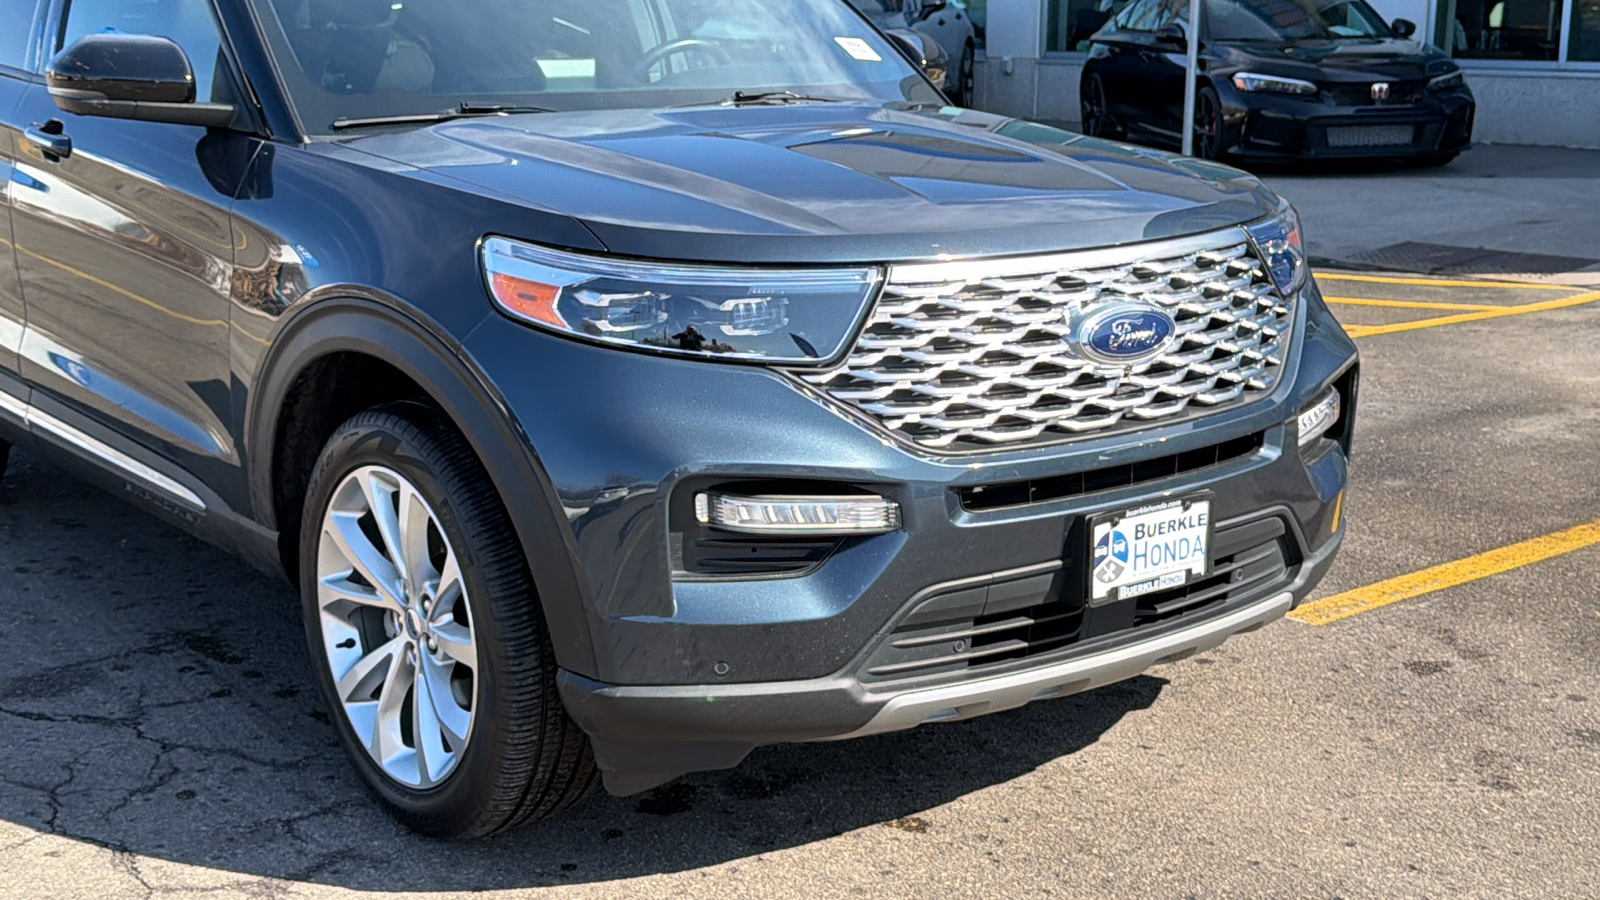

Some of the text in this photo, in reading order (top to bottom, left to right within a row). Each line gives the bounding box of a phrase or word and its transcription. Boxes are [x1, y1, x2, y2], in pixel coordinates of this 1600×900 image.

[1109, 318, 1157, 350] Ford
[1134, 513, 1207, 540] BUERKLE
[1133, 534, 1206, 571] HONDA
[1120, 579, 1160, 598] BUERKLE
